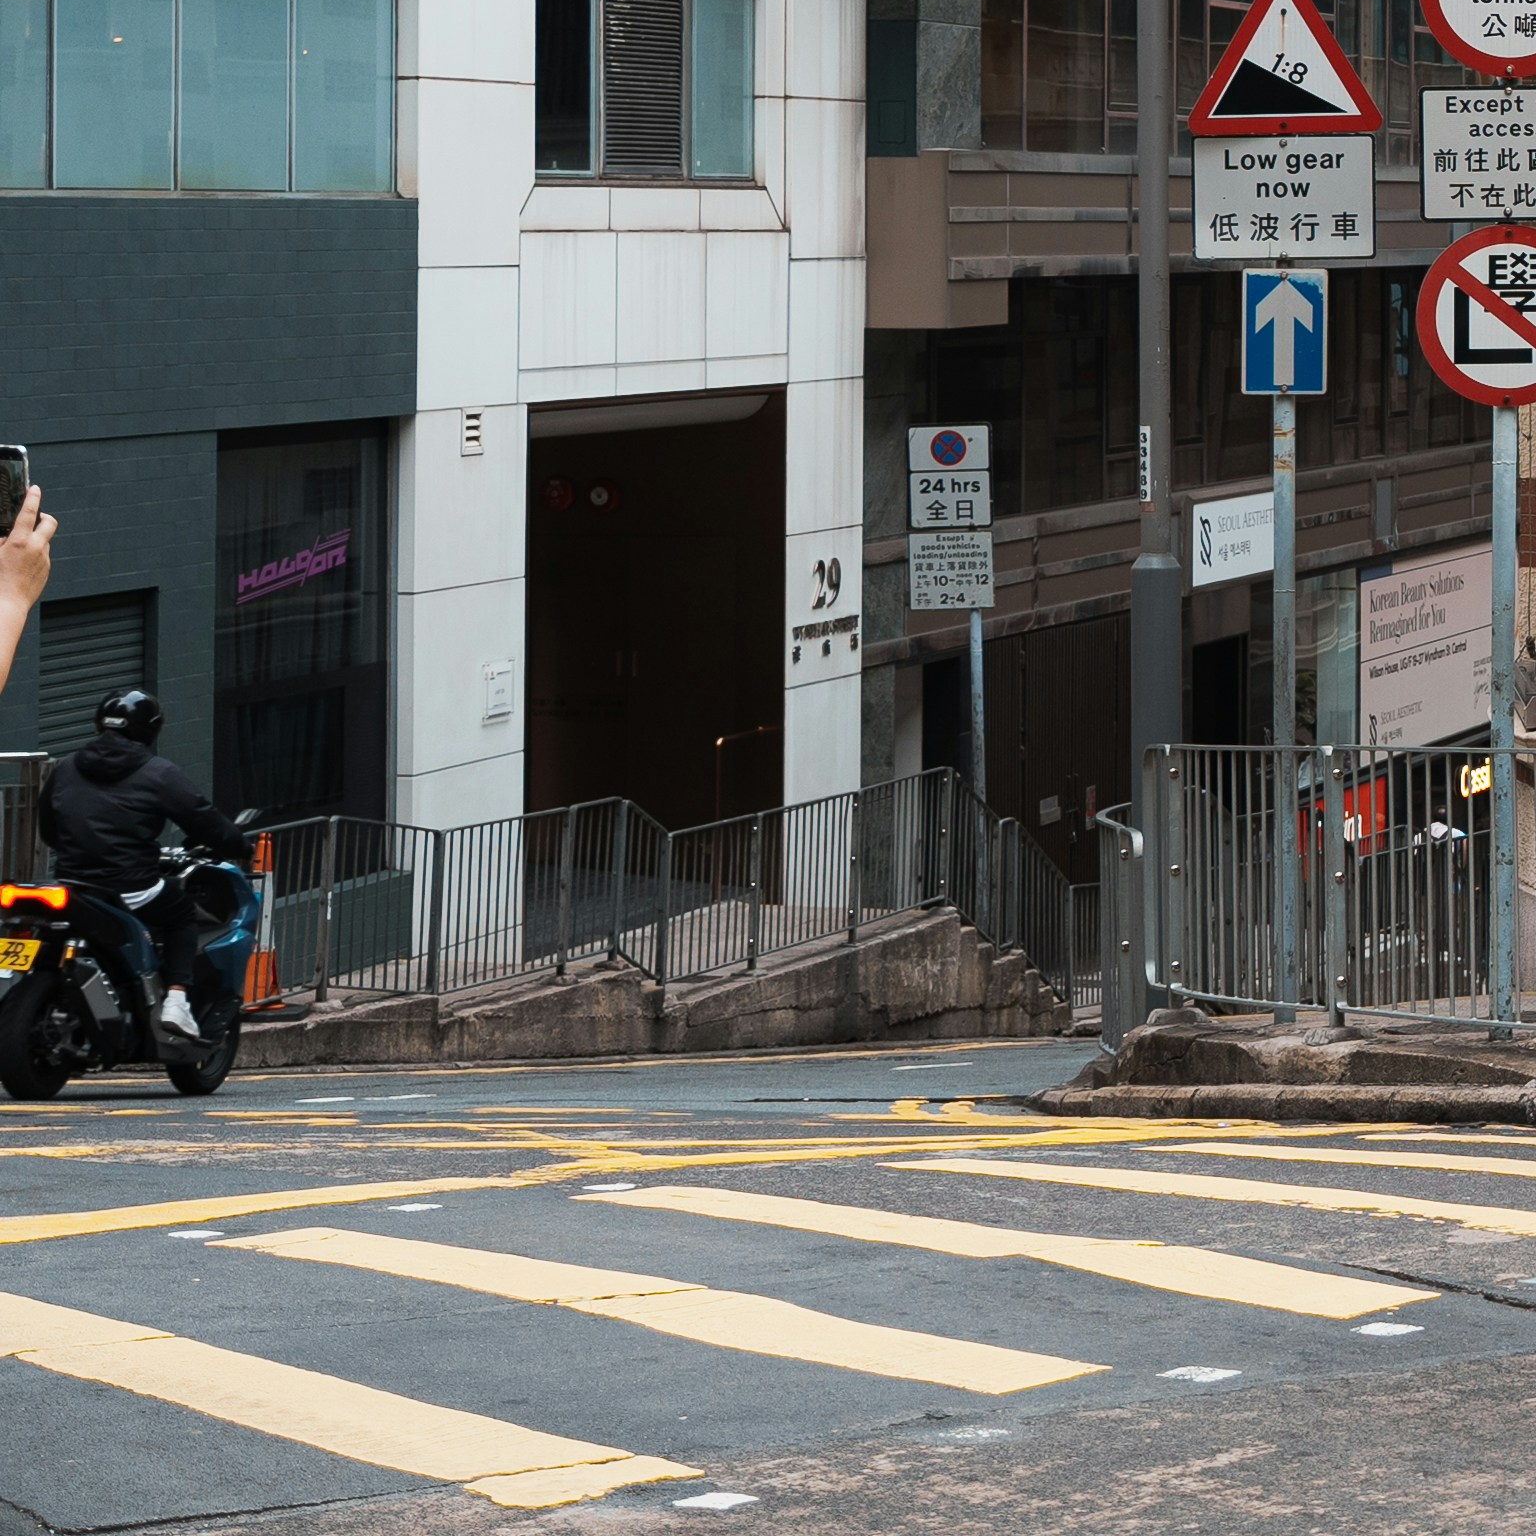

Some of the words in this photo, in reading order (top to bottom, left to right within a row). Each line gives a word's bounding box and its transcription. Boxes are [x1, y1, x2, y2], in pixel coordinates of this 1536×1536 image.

[1269, 51, 1309, 86] 1:8
[1445, 94, 1524, 118] Except
[1223, 149, 1278, 170] Low
[1285, 150, 1345, 178] gear
[1255, 182, 1311, 199] now
[1209, 211, 1361, 243] 低波行車
[919, 478, 946, 494] 24
[951, 478, 981, 494] hrs
[926, 499, 974, 521] 全日
[1217, 514, 1241, 533] SEOUL
[1242, 508, 1275, 529] AESTHET
[811, 557, 842, 610] 29
[974, 574, 989, 585] 12
[1369, 588, 1400, 614] Korean
[1400, 581, 1427, 606] Beauty
[1429, 570, 1465, 598] Solutions
[1369, 606, 1418, 644] Reimagined
[1418, 603, 1430, 631] for
[1431, 603, 1446, 627] You
